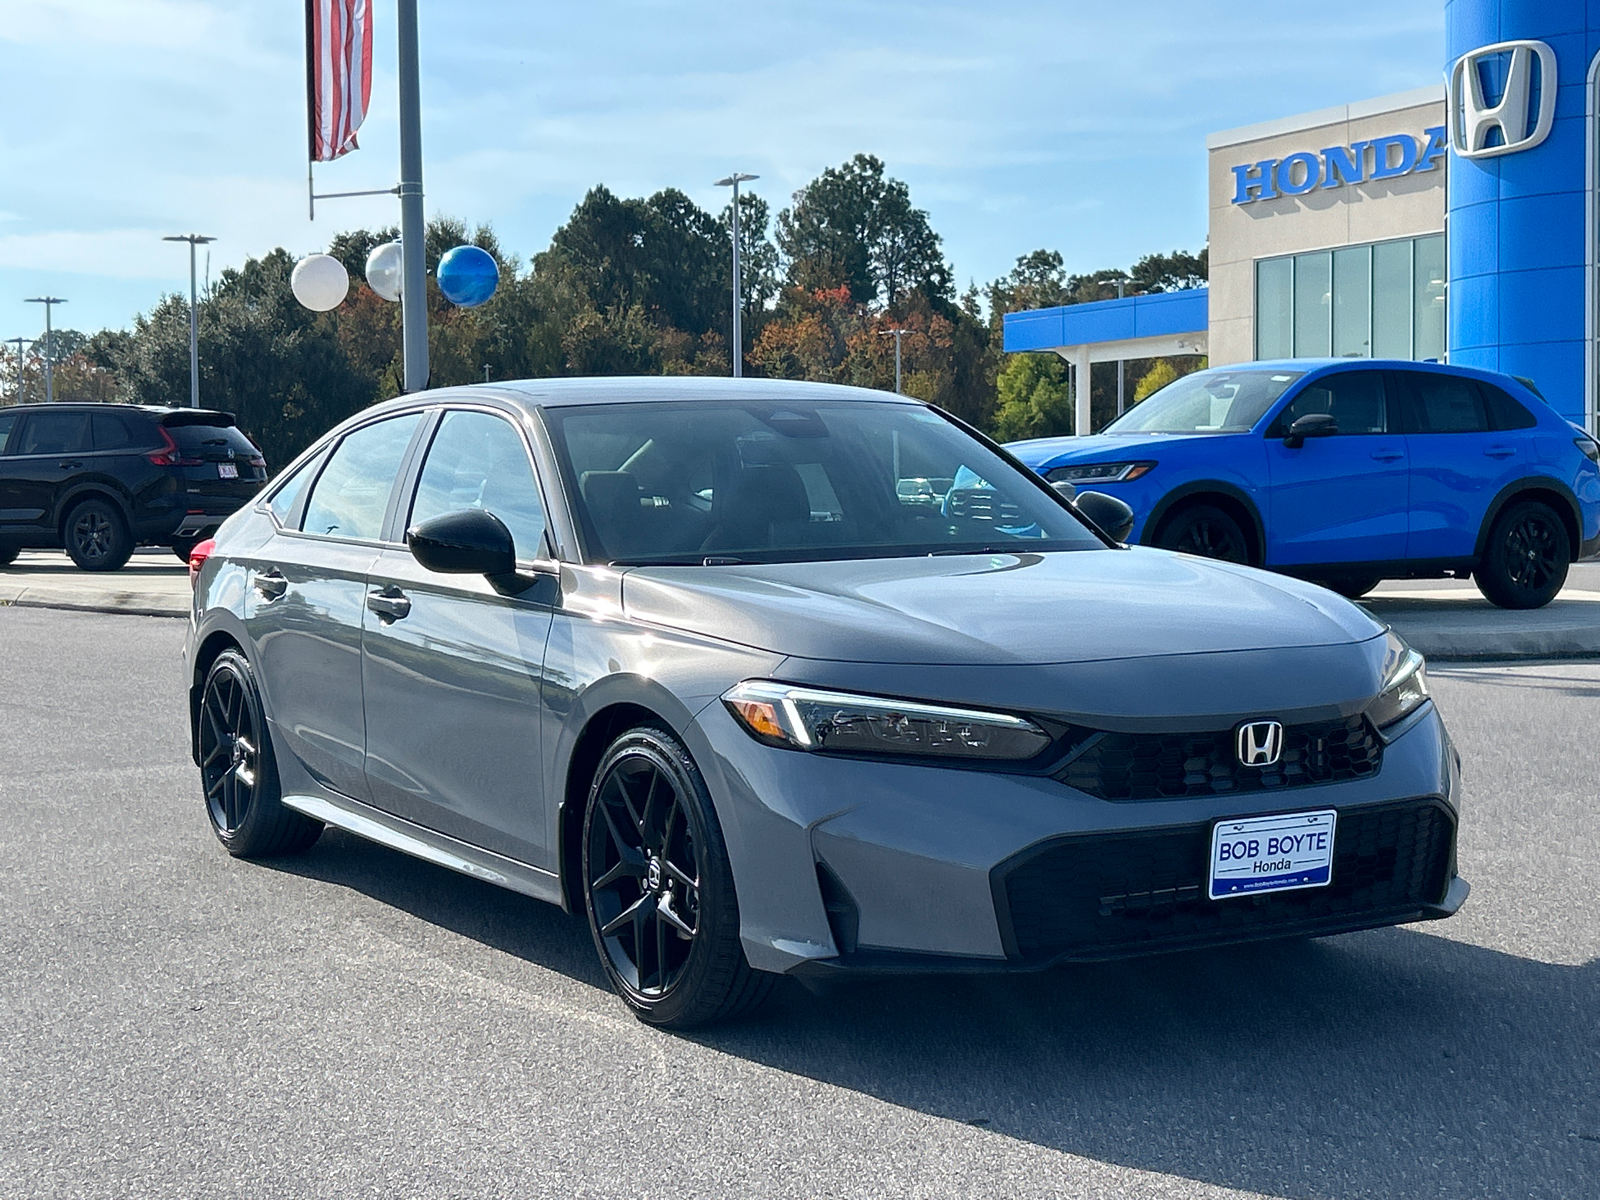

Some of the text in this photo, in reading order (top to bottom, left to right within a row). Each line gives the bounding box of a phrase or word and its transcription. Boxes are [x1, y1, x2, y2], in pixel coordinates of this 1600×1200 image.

[1231, 125, 1446, 205] HONDA
[1219, 832, 1328, 861] BOB BOYTE
[1253, 858, 1291, 873] Honda
